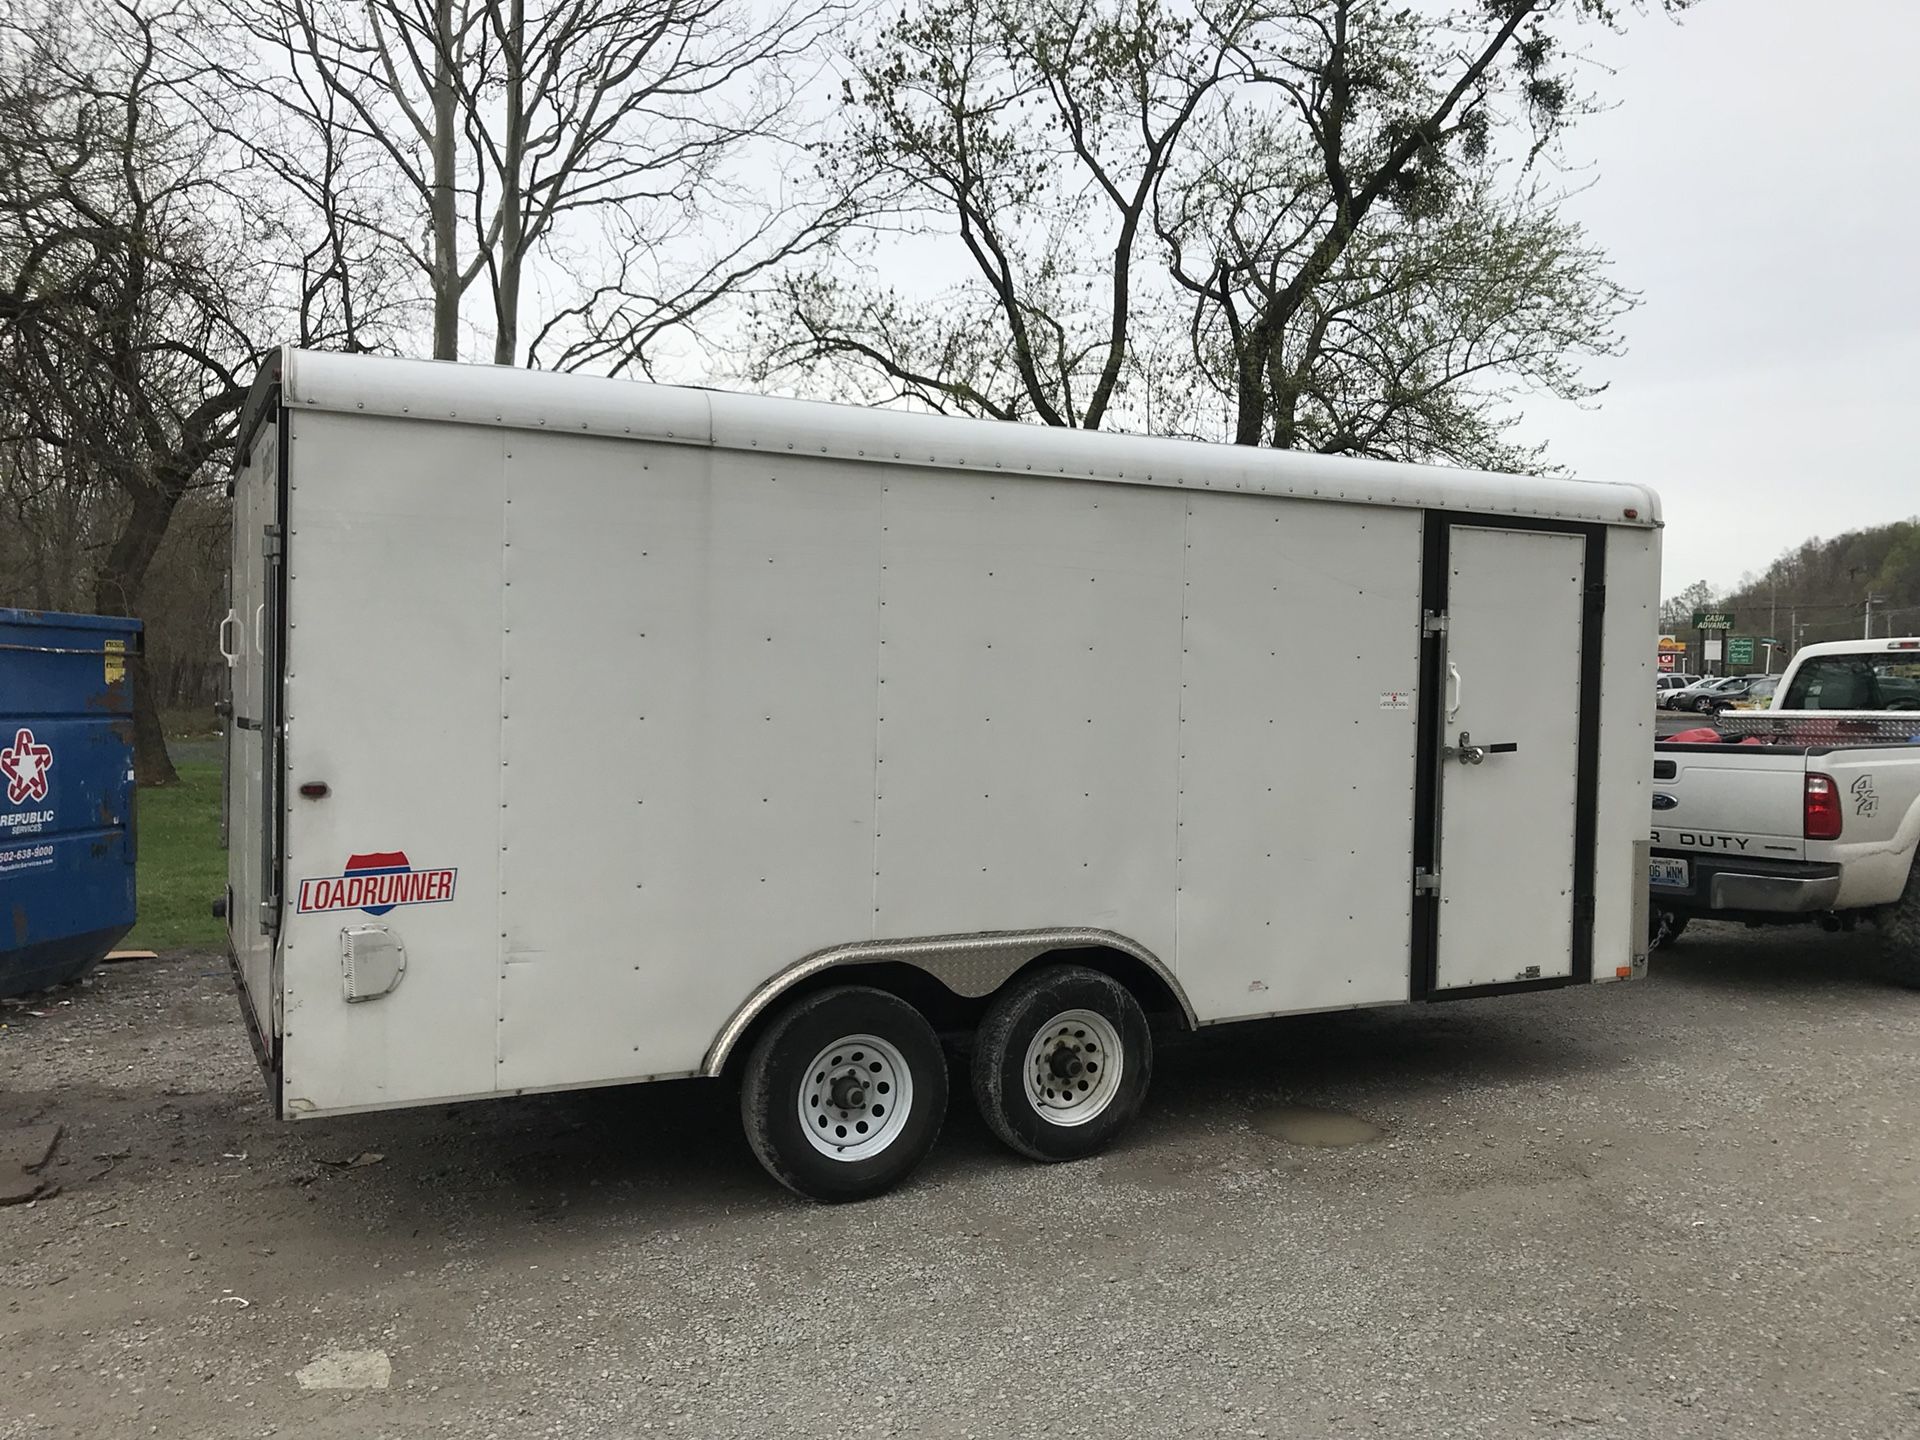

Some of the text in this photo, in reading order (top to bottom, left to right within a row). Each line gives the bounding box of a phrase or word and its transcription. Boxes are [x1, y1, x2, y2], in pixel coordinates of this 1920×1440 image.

[1704, 614, 1725, 622] CASH
[1697, 621, 1731, 630] ADVANCE
[0, 810, 54, 827] REPUBLIC
[12, 823, 42, 835] SERVICES
[1679, 833, 1750, 850] DUTY
[1666, 866, 1683, 880] WNM
[301, 871, 453, 911] LOADRUNNER
